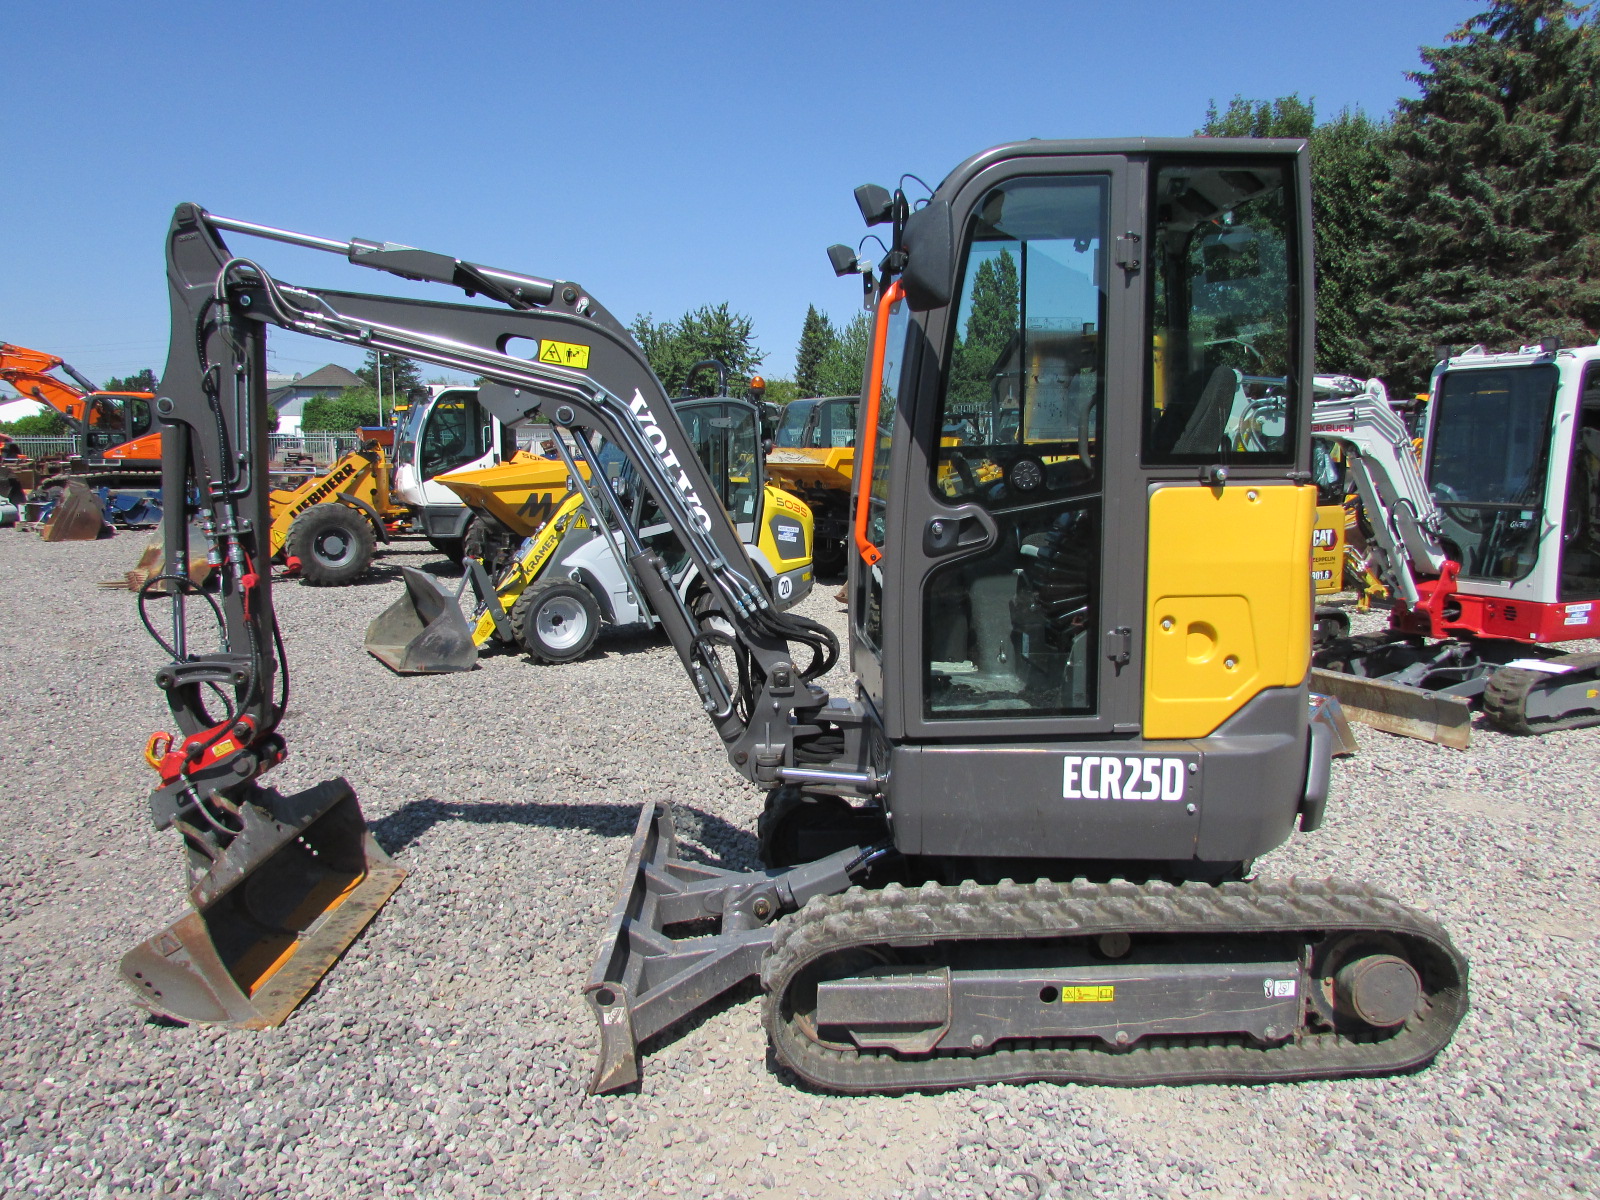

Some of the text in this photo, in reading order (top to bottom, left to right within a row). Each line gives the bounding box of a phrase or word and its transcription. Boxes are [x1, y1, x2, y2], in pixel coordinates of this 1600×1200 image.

[1311, 424, 1355, 433] AKEUCHI
[776, 496, 808, 518] 5035
[1313, 529, 1333, 547] CAT
[523, 534, 558, 577] KRAMER
[780, 580, 790, 596] 20
[1063, 756, 1184, 801] ECR25D
